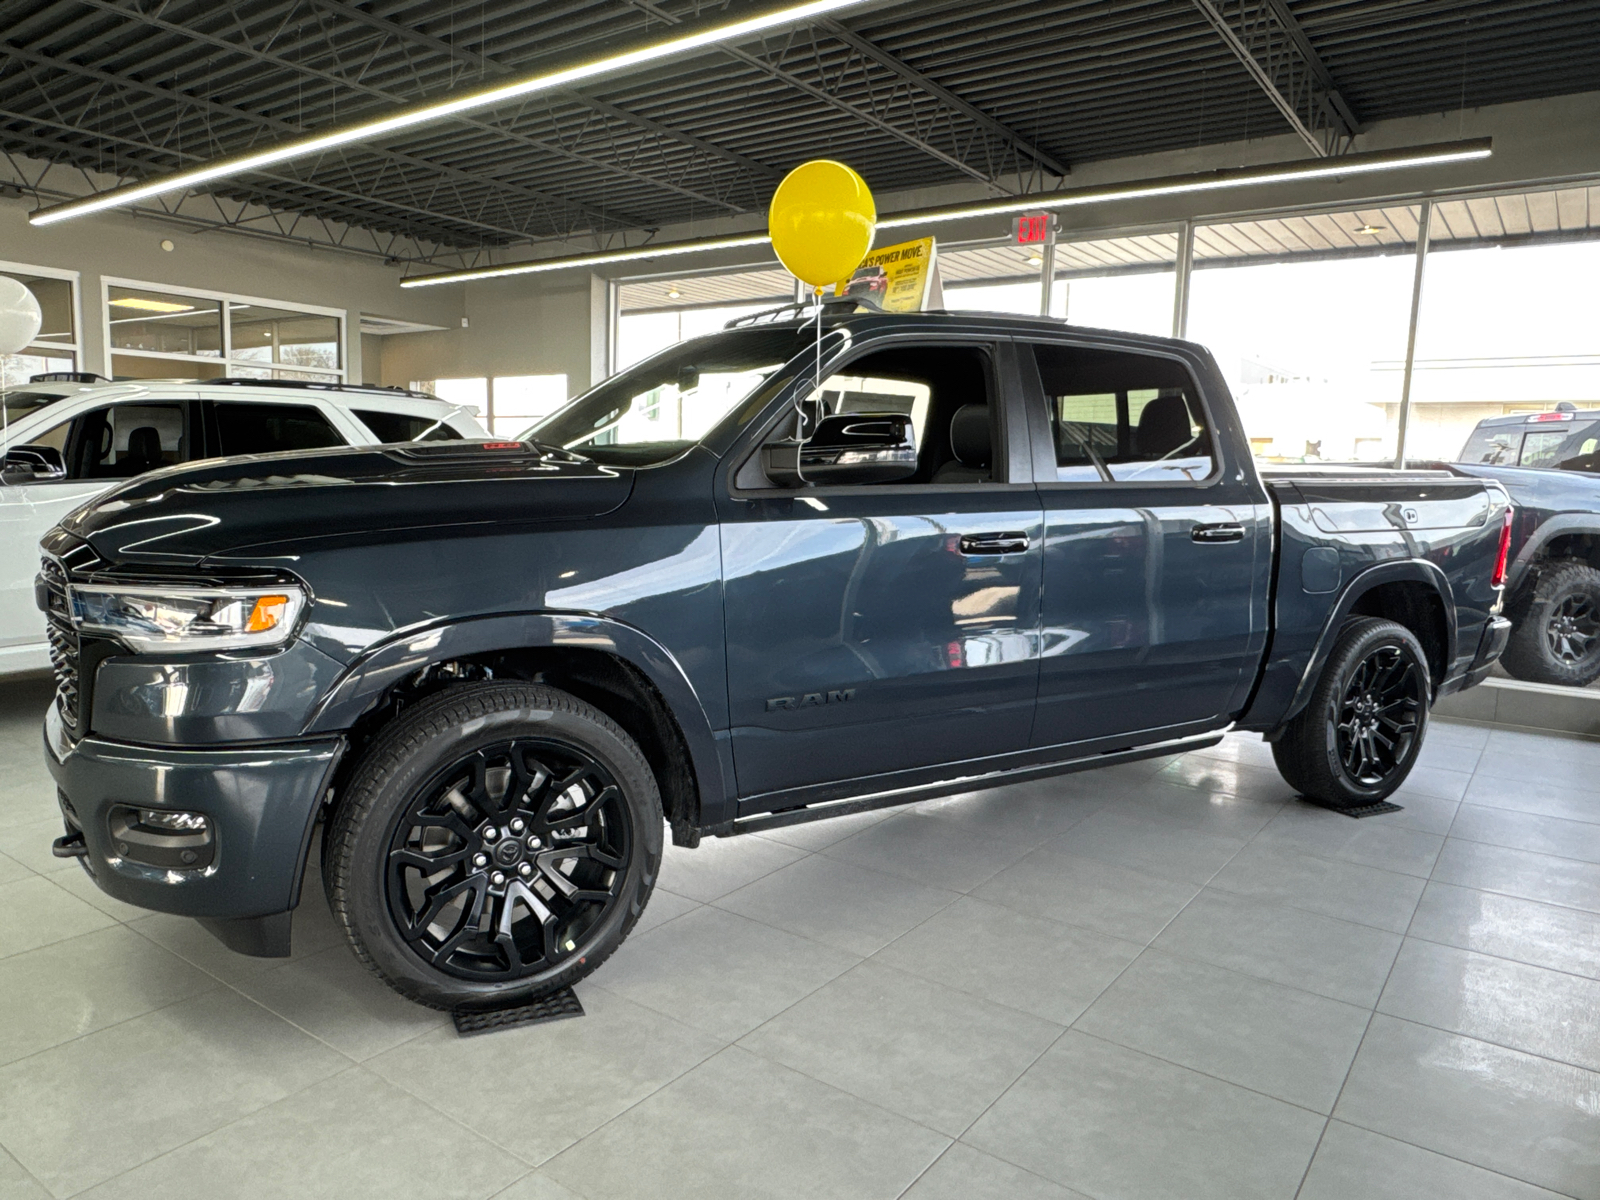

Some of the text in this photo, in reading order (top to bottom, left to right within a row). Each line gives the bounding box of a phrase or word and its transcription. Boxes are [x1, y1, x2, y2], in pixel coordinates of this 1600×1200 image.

[1018, 215, 1049, 243] EXIT
[857, 256, 875, 269] CA'S
[875, 250, 901, 266] POWER
[764, 688, 857, 712] RAM
